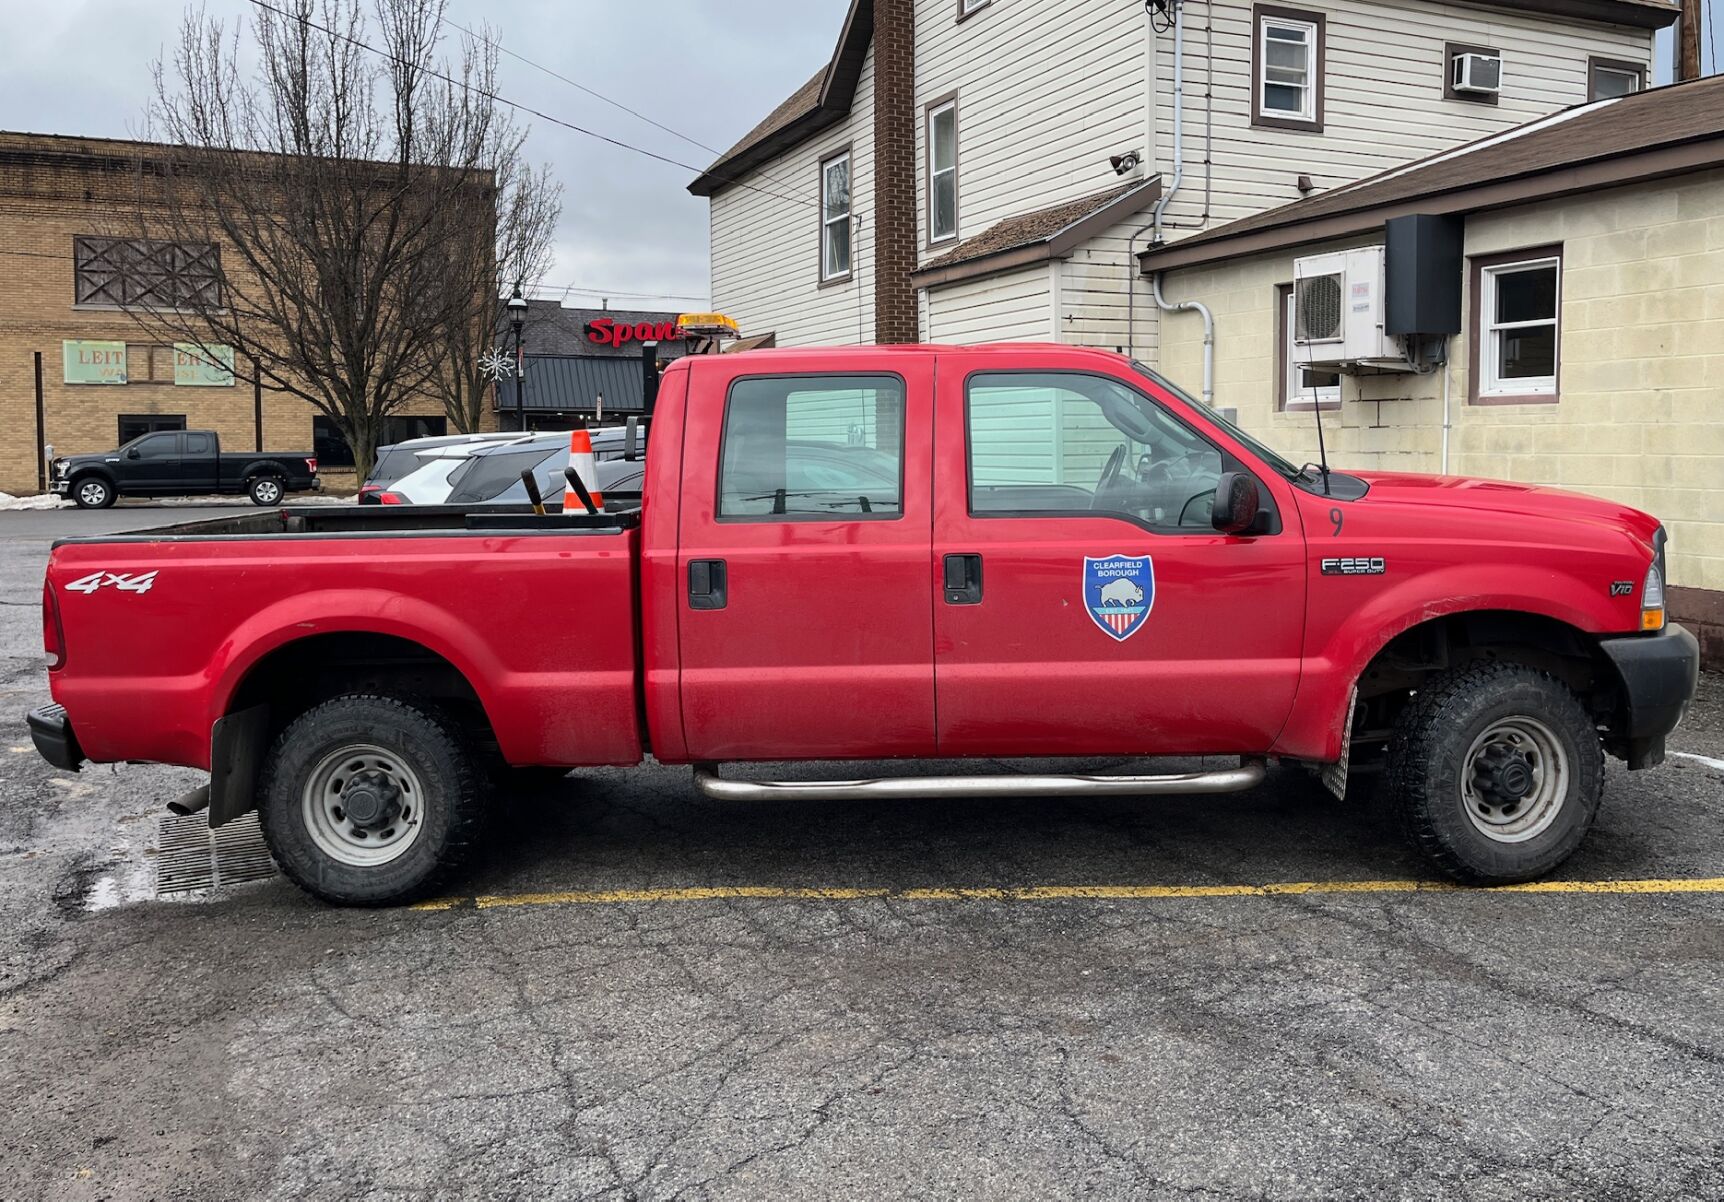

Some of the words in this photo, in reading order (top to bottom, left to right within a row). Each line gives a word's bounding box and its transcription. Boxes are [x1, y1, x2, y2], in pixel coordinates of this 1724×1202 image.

[588, 317, 684, 348] Span
[79, 350, 124, 365] LEIT
[1329, 508, 1343, 537] 9
[1093, 561, 1143, 570] CLEARFIELD
[1097, 569, 1139, 577] BOROUGH
